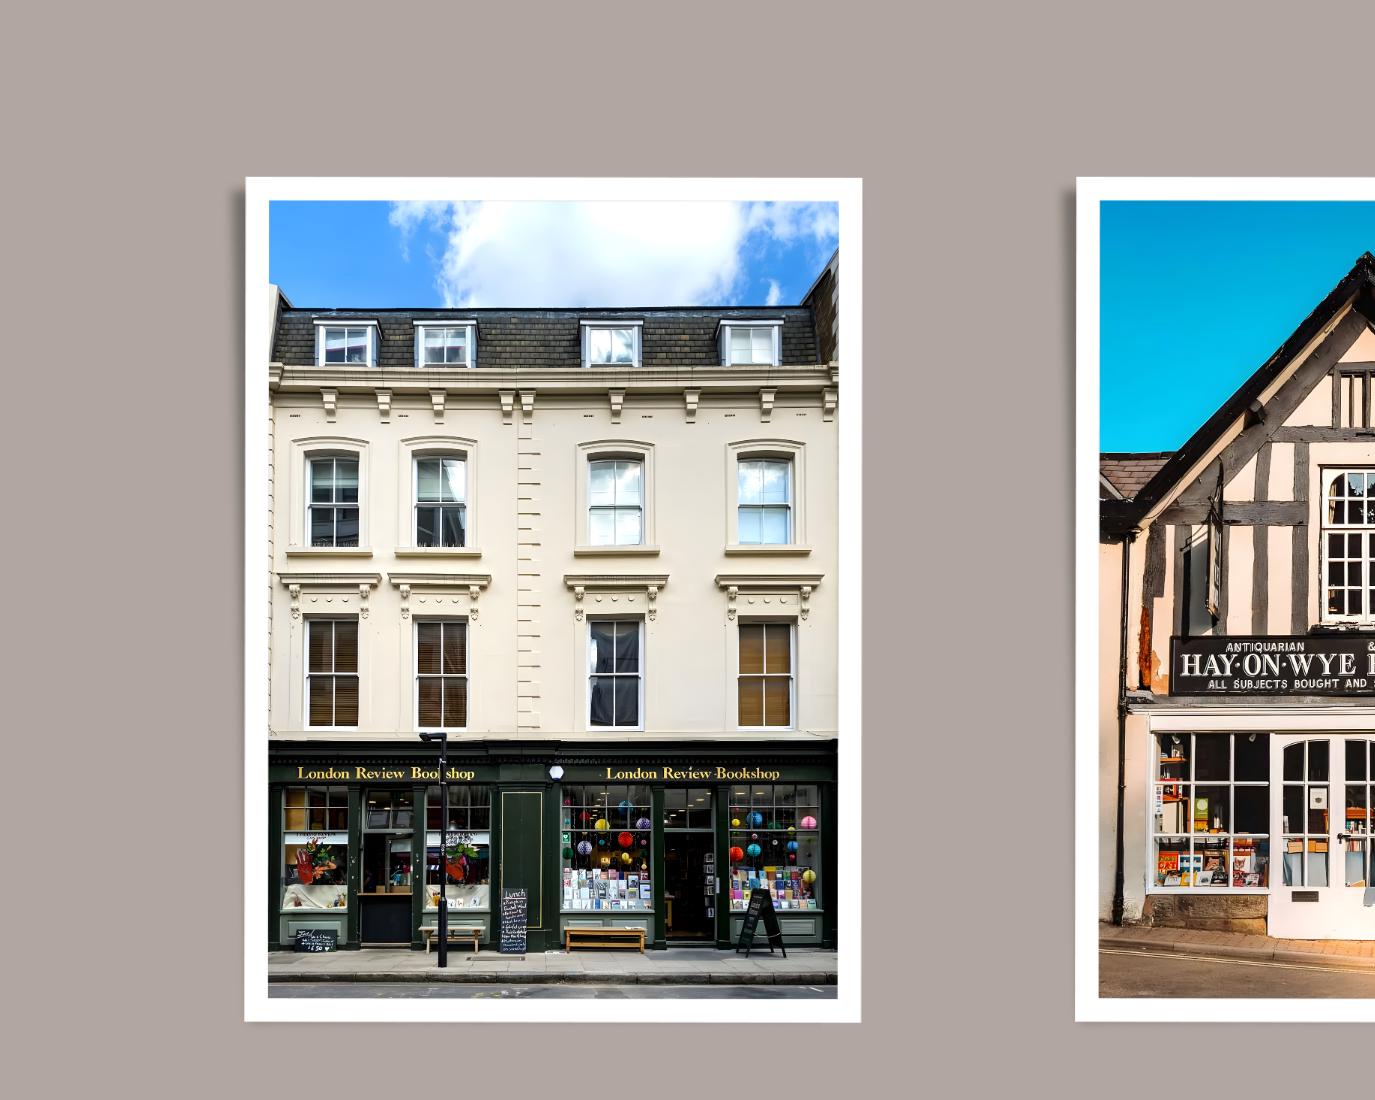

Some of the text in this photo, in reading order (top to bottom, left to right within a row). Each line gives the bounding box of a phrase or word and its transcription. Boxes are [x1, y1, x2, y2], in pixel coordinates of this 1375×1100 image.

[1226, 642, 1305, 652] ANTIQUARIAN
[1208, 679, 1227, 689] ALL
[1233, 678, 1288, 689] SUBJECTS
[1294, 678, 1340, 689] BOUGHT
[1345, 678, 1367, 688] AND
[297, 766, 350, 779] London
[355, 766, 405, 779] Review
[606, 766, 780, 780] London Review Bookshop
